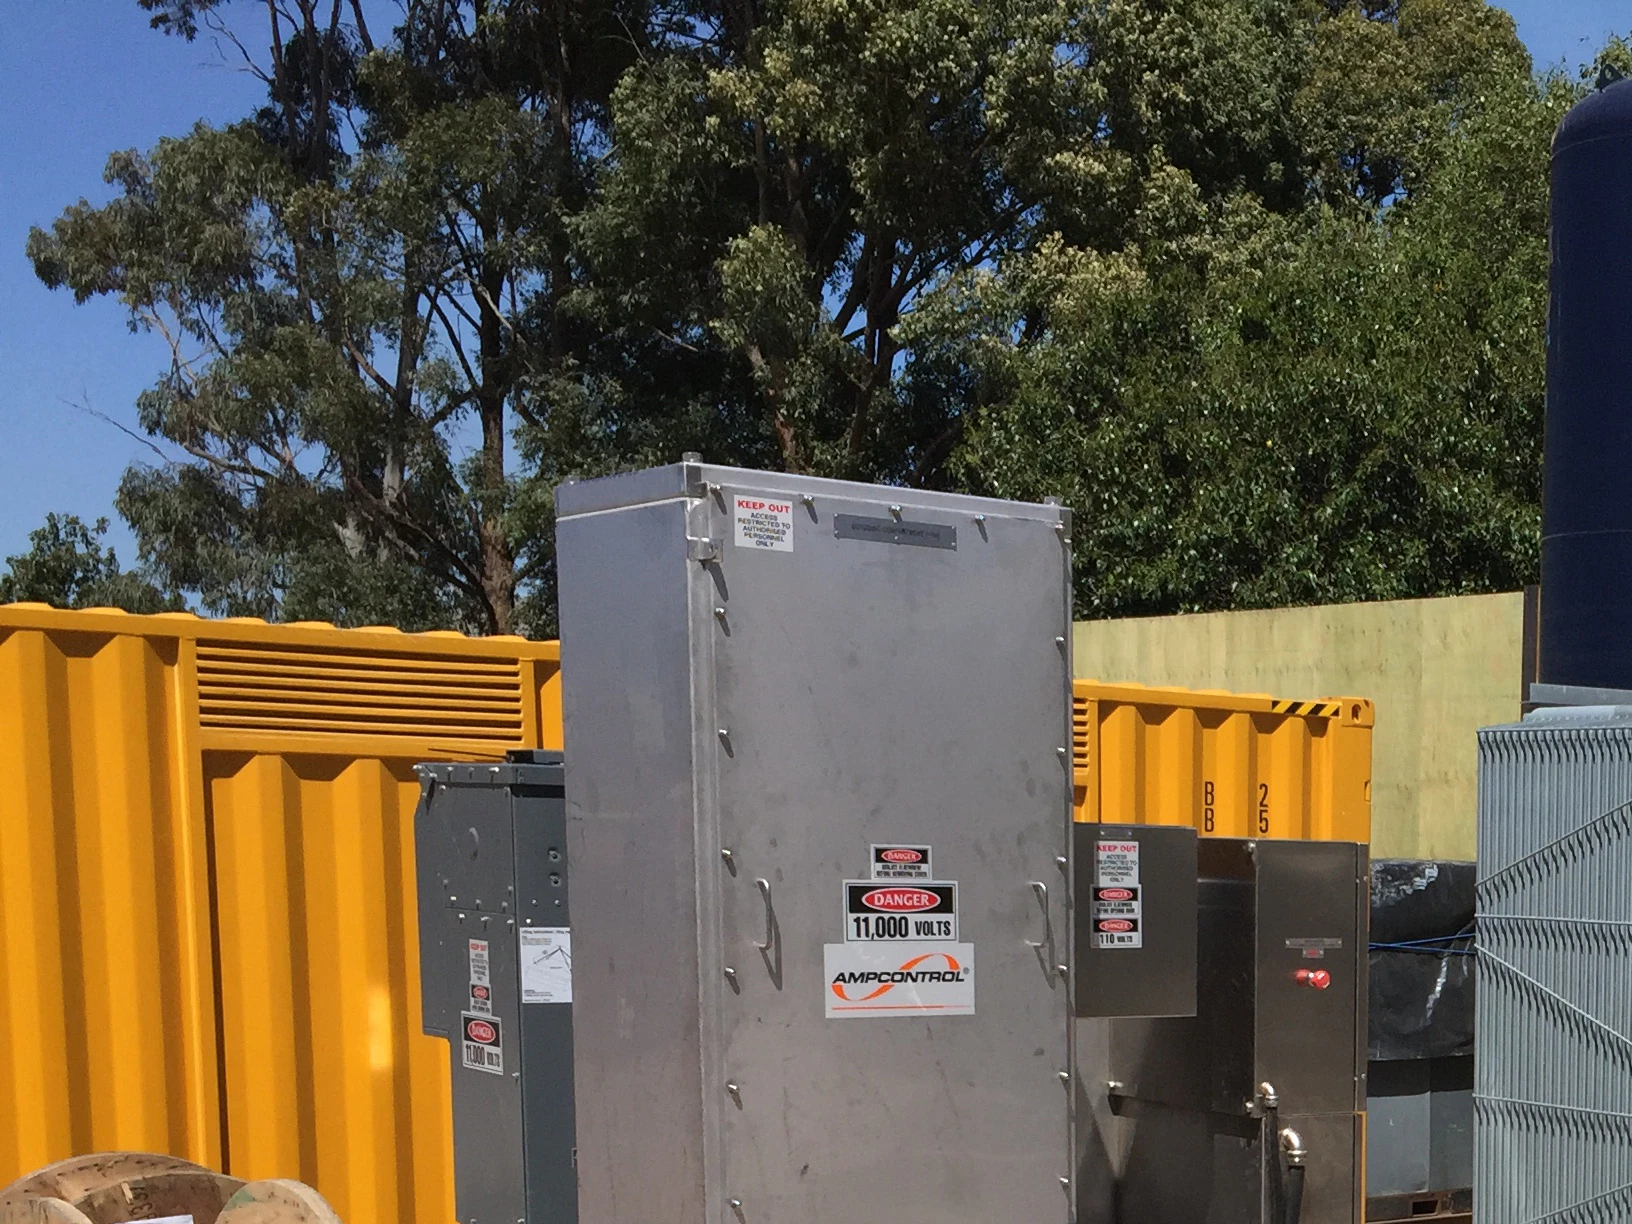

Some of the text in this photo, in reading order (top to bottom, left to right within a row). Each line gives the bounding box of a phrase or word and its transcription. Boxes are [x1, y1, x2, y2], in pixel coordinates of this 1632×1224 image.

[738, 500, 790, 513] KEEP OUT
[887, 852, 916, 860] DANGER
[874, 893, 930, 906] DANGER
[853, 915, 951, 940] 11,000 VOLTS
[1100, 933, 1115, 944] 110
[832, 971, 965, 983] AMPCONTROL
